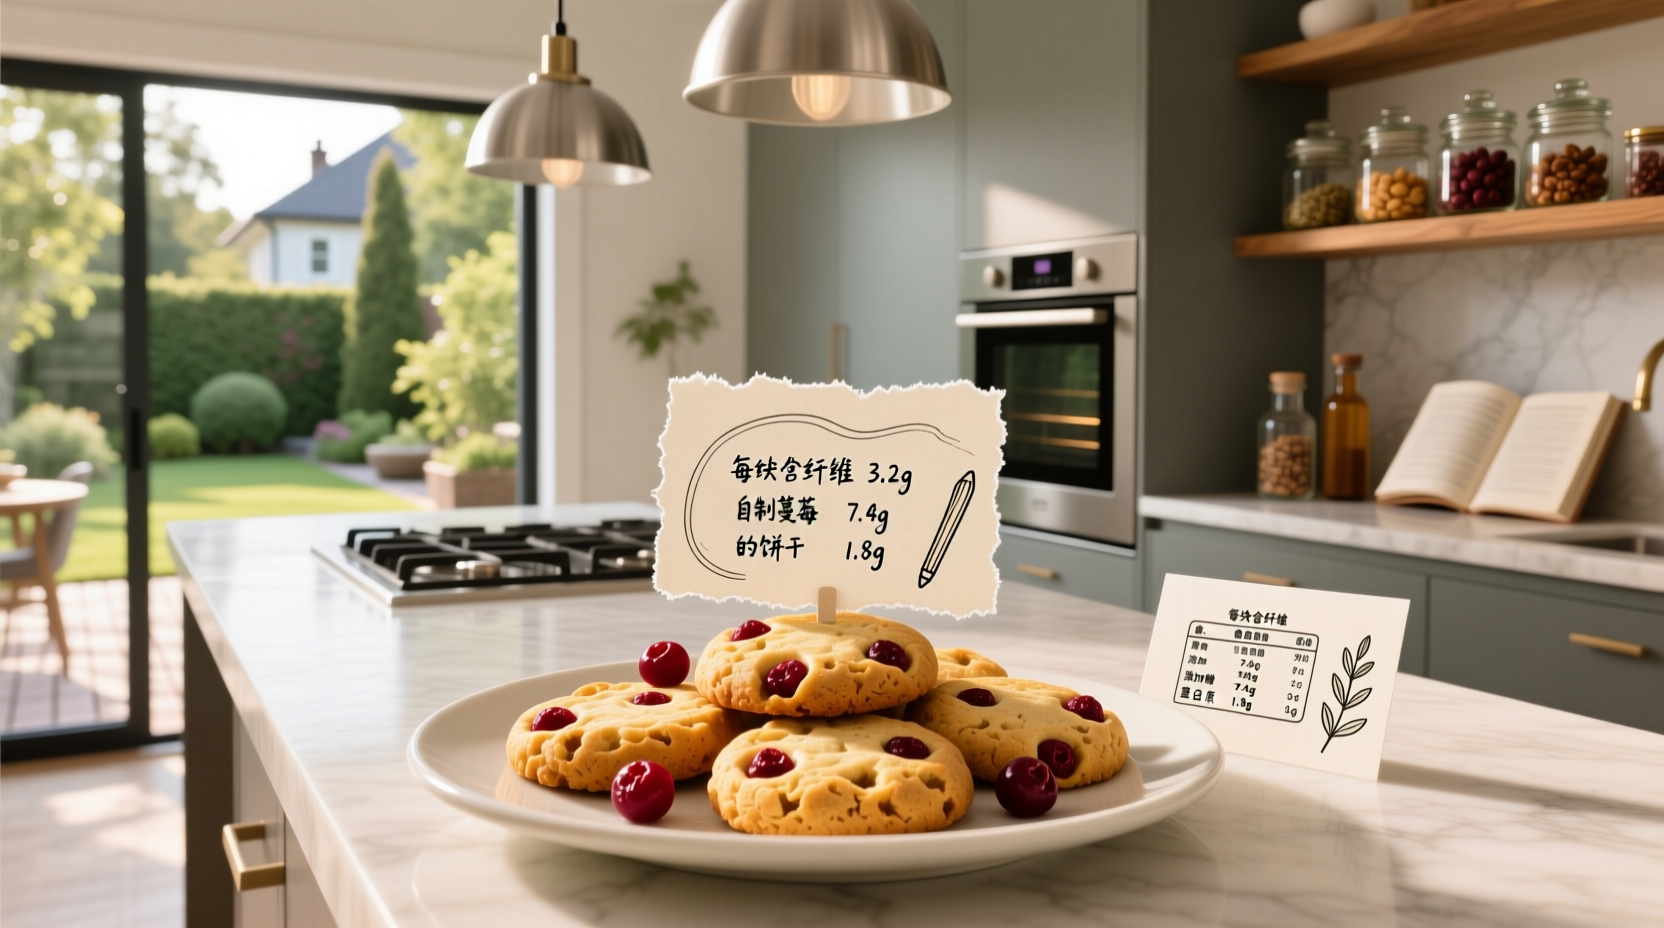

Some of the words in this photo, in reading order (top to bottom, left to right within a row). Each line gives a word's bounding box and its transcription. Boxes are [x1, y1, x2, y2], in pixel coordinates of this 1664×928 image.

[867, 462, 913, 496] 3.2g
[847, 502, 889, 535] 7.4g
[736, 533, 805, 563] 的饼干
[845, 539, 885, 572] 1.8g
